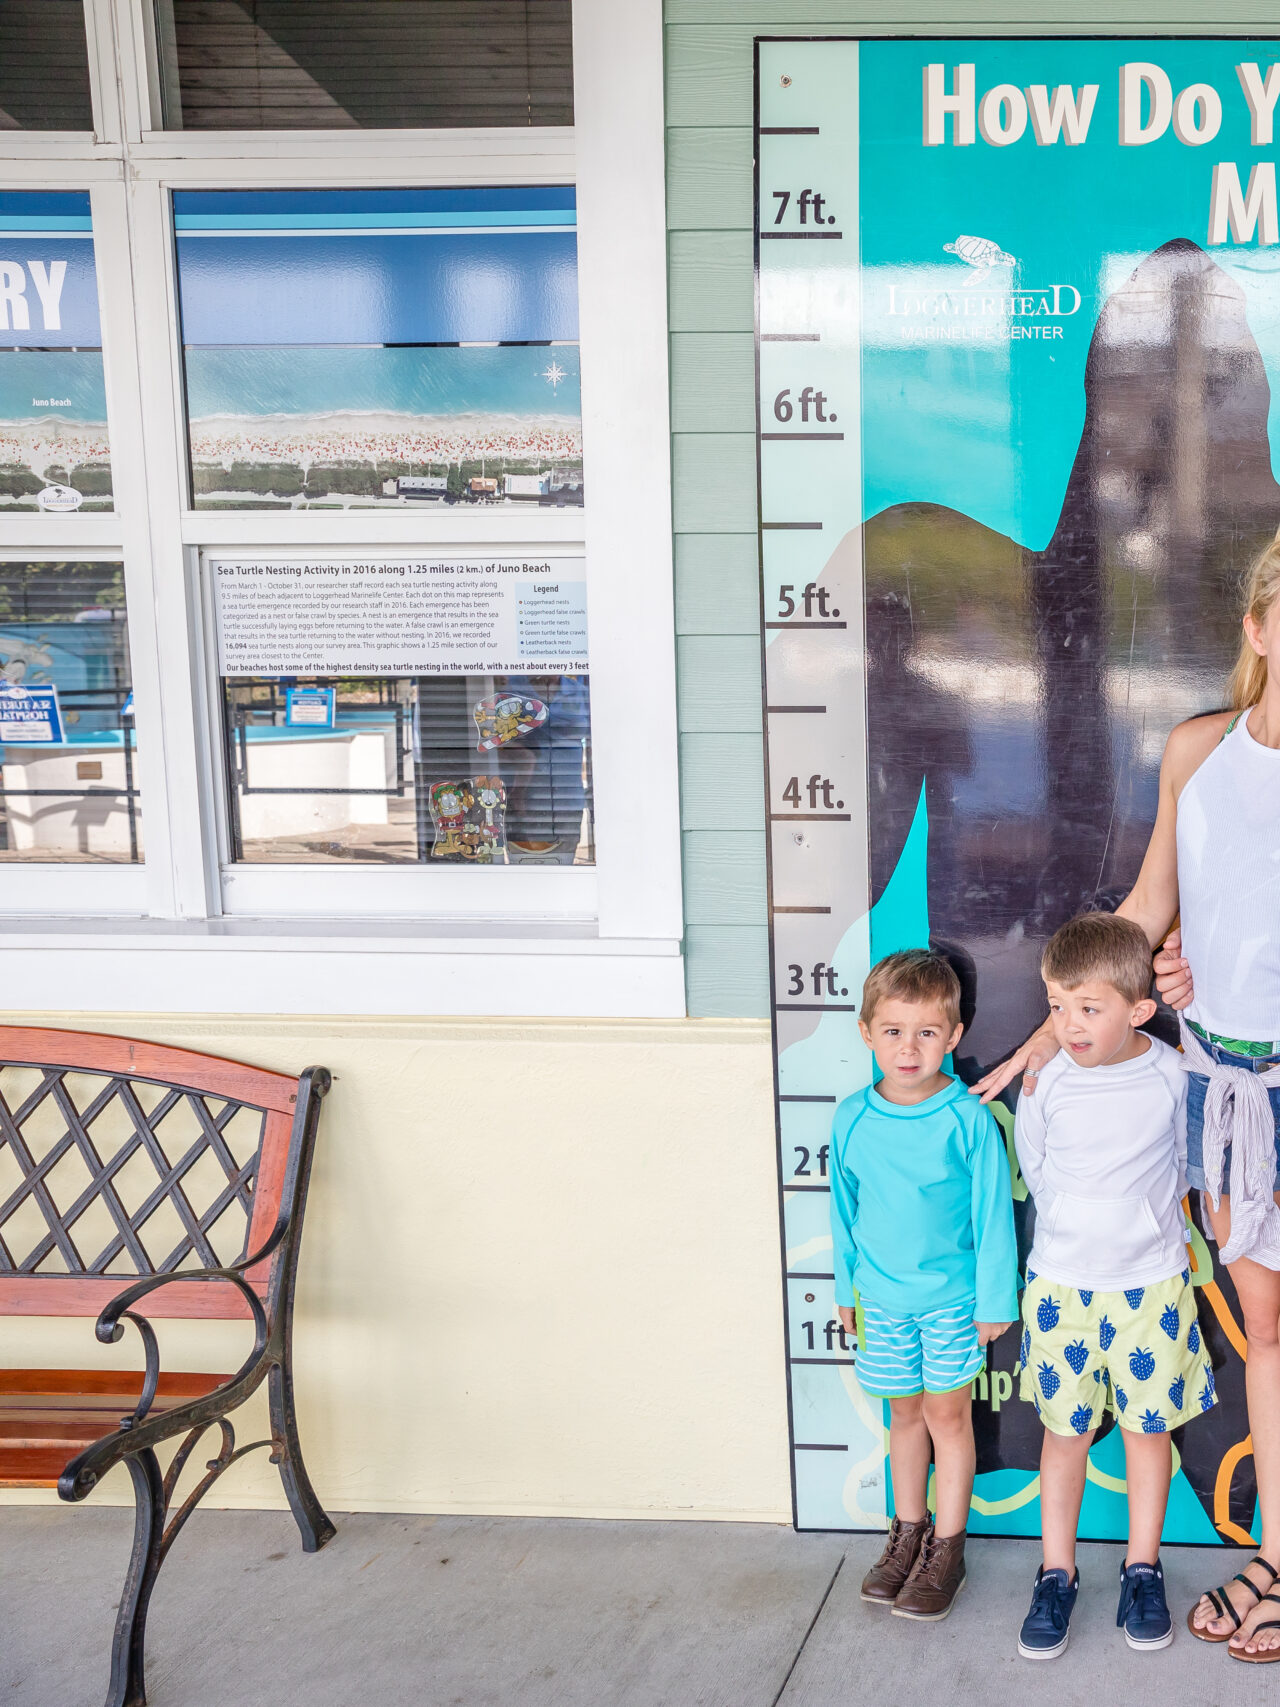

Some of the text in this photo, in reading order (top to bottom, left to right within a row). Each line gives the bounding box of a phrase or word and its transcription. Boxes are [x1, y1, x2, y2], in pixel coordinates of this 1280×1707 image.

[922, 63, 1099, 146] How
[1119, 62, 1222, 146] Do
[772, 189, 835, 224] 7 ft.
[886, 284, 1081, 316] LOGGERHEAD
[902, 326, 1063, 339] MARINELIFE CENTER
[32, 398, 72, 407] Juno Beach
[774, 387, 837, 422] 6 ft.
[218, 564, 550, 576] Sea Turtle Nesting Activity in 2016 along 1.25 miles (2 km.) of Juno Beach
[277, 592, 303, 600] adjacent
[312, 592, 350, 600] Loggerhead
[471, 591, 504, 600] represents
[431, 581, 455, 590] nesting
[456, 581, 478, 590] activity
[480, 581, 498, 589] along
[534, 584, 558, 594] Legend
[321, 602, 329, 610] by
[778, 582, 840, 618] 5 ft.
[295, 642, 312, 651] along
[376, 642, 400, 650] graphic
[226, 663, 238, 671] Our
[240, 663, 267, 671] beaches
[269, 663, 284, 671] host
[305, 663, 312, 671] of
[313, 663, 325, 671] the
[326, 663, 352, 673] highest
[354, 662, 378, 673] density
[393, 662, 413, 671] turtle
[414, 662, 440, 672] nesting
[442, 662, 449, 671] in
[450, 662, 462, 670] the
[463, 662, 485, 672] world,
[487, 662, 503, 670] with
[510, 662, 525, 670] nest
[526, 662, 547, 670] about
[548, 664, 567, 672] every
[574, 662, 589, 670] feet
[782, 774, 844, 809] 4 ft.
[788, 962, 848, 996] 3 ft.
[794, 1146, 810, 1176] 2
[801, 1321, 814, 1350] 1
